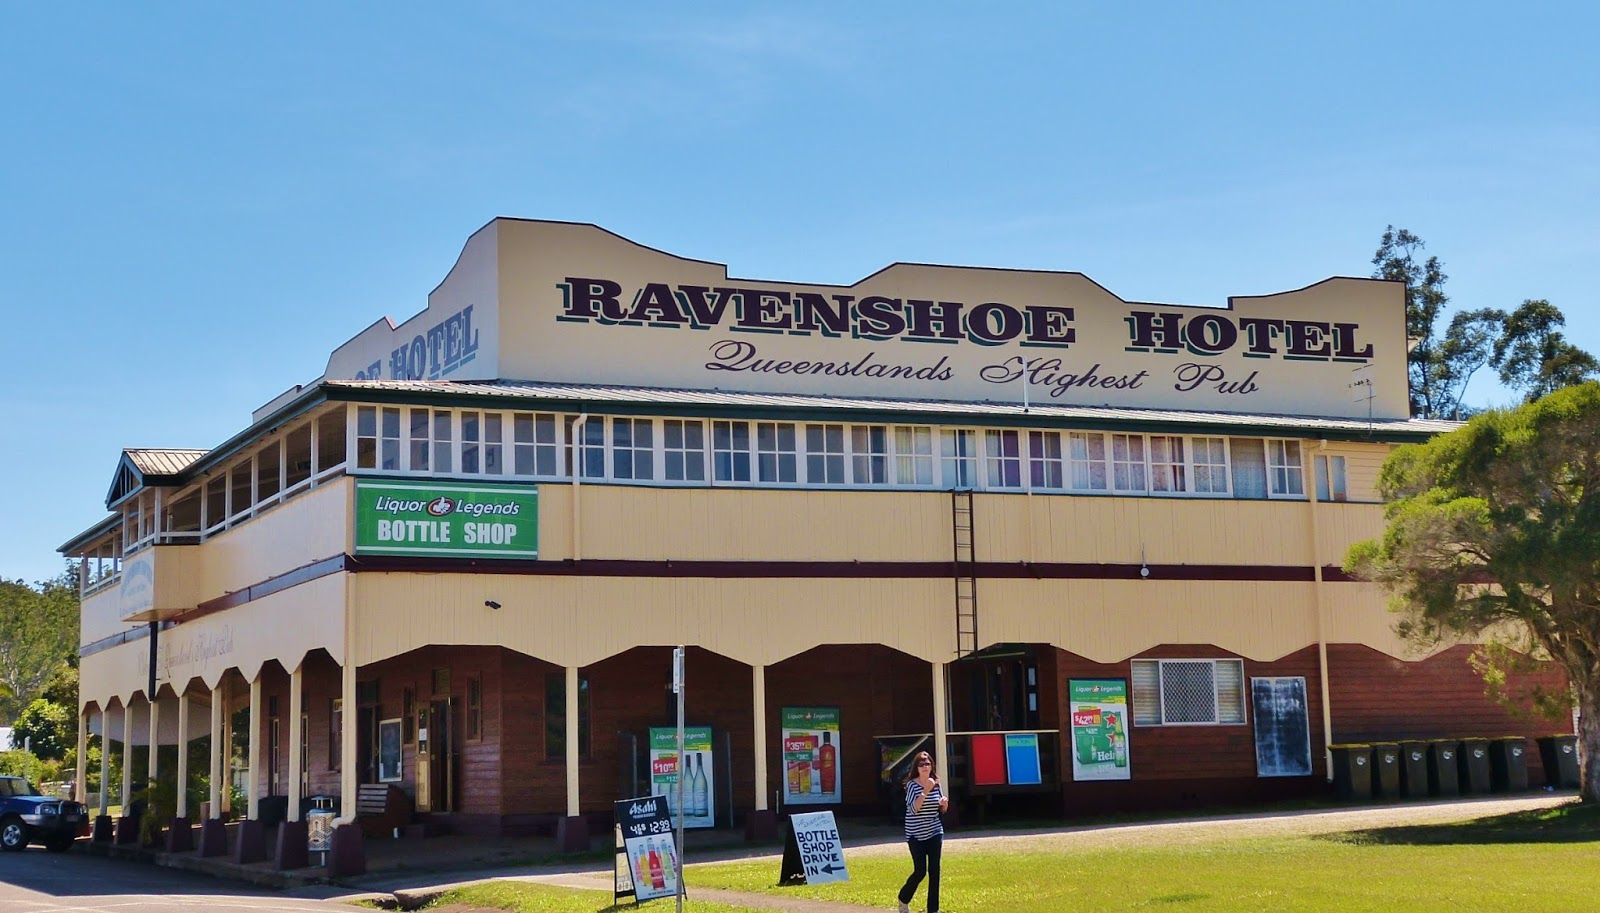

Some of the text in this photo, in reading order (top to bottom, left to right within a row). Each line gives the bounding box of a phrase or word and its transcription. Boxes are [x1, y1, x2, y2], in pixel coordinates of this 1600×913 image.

[556, 277, 1374, 363] RAVENSHOE HOTEL
[390, 304, 479, 381] HOTEL
[705, 339, 1259, 398] Queenslands Highest Pub
[375, 496, 520, 517] Liquor Legends
[378, 519, 517, 544] BOTTLE SHOP
[629, 799, 657, 815] Asahi
[796, 830, 838, 843] BOTTLE
[802, 842, 834, 854] SHOP
[803, 853, 839, 865] DRIVE
[806, 865, 819, 877] IN
